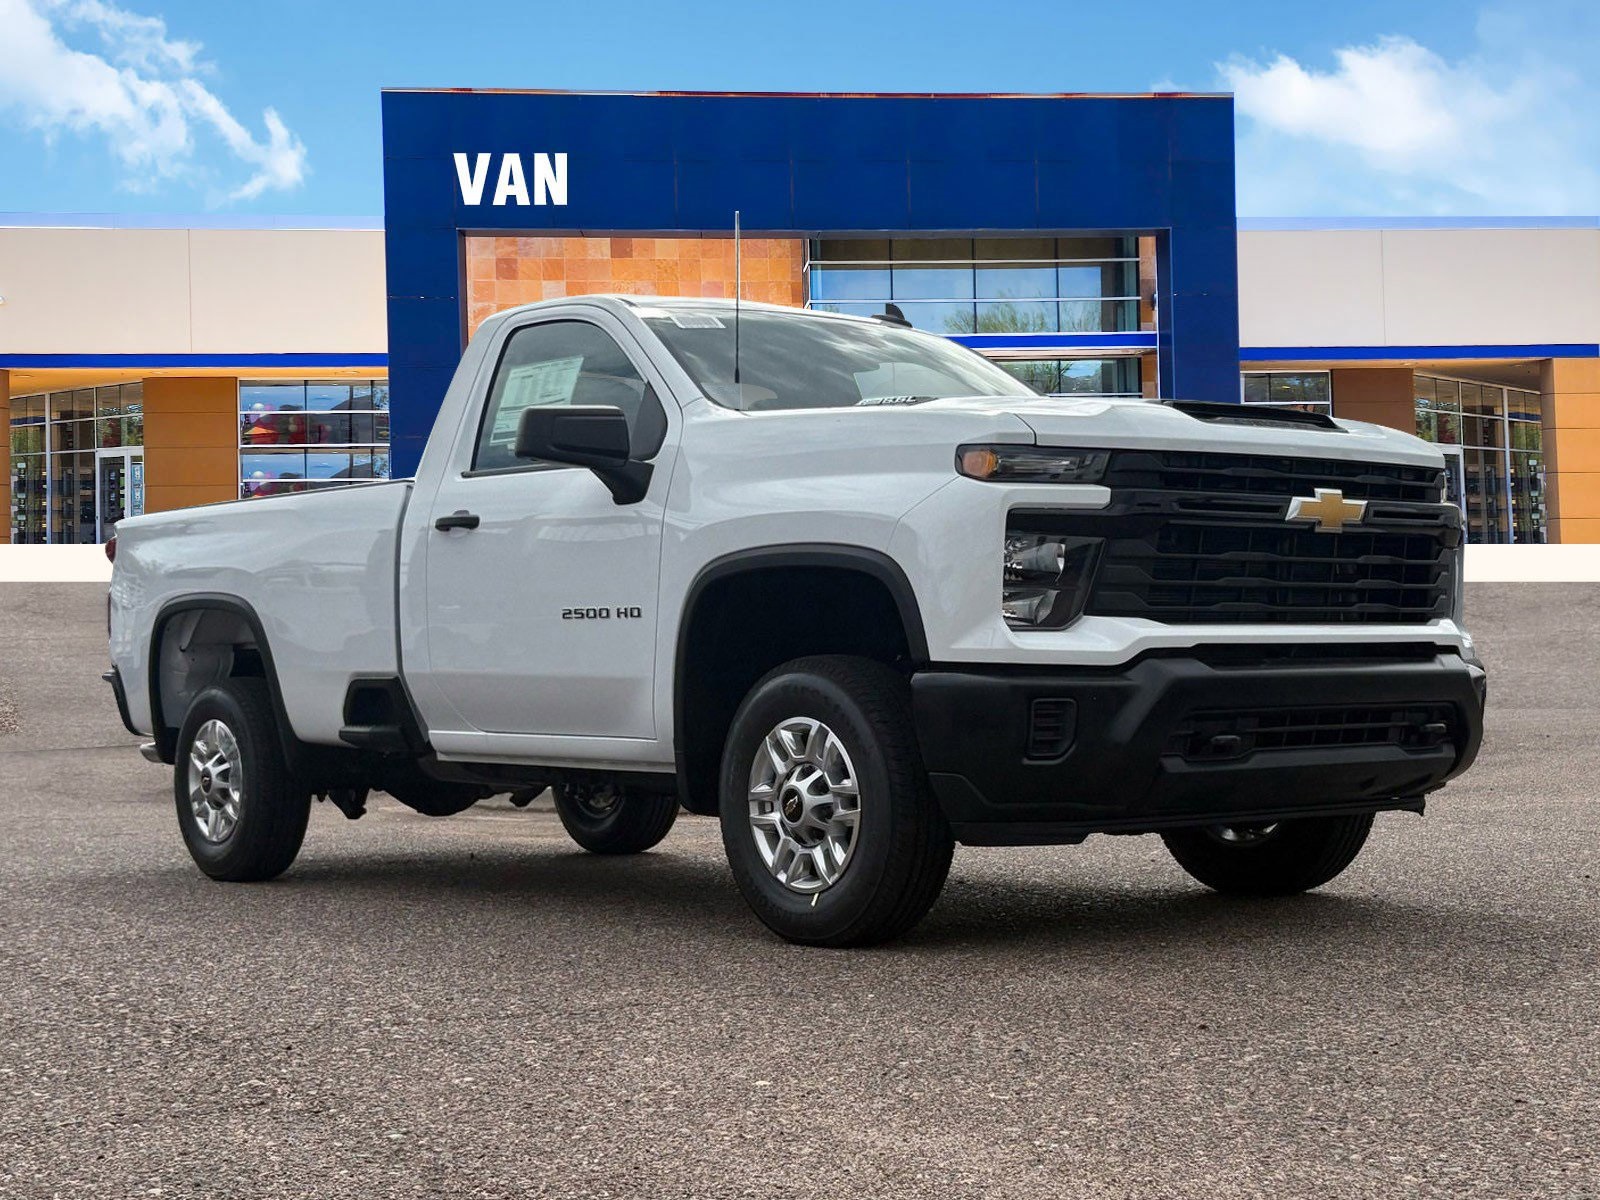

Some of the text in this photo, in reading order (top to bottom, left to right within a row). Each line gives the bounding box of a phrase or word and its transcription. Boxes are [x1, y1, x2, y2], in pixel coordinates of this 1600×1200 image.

[453, 152, 568, 206] VAN
[562, 607, 642, 619] 2500 HD
